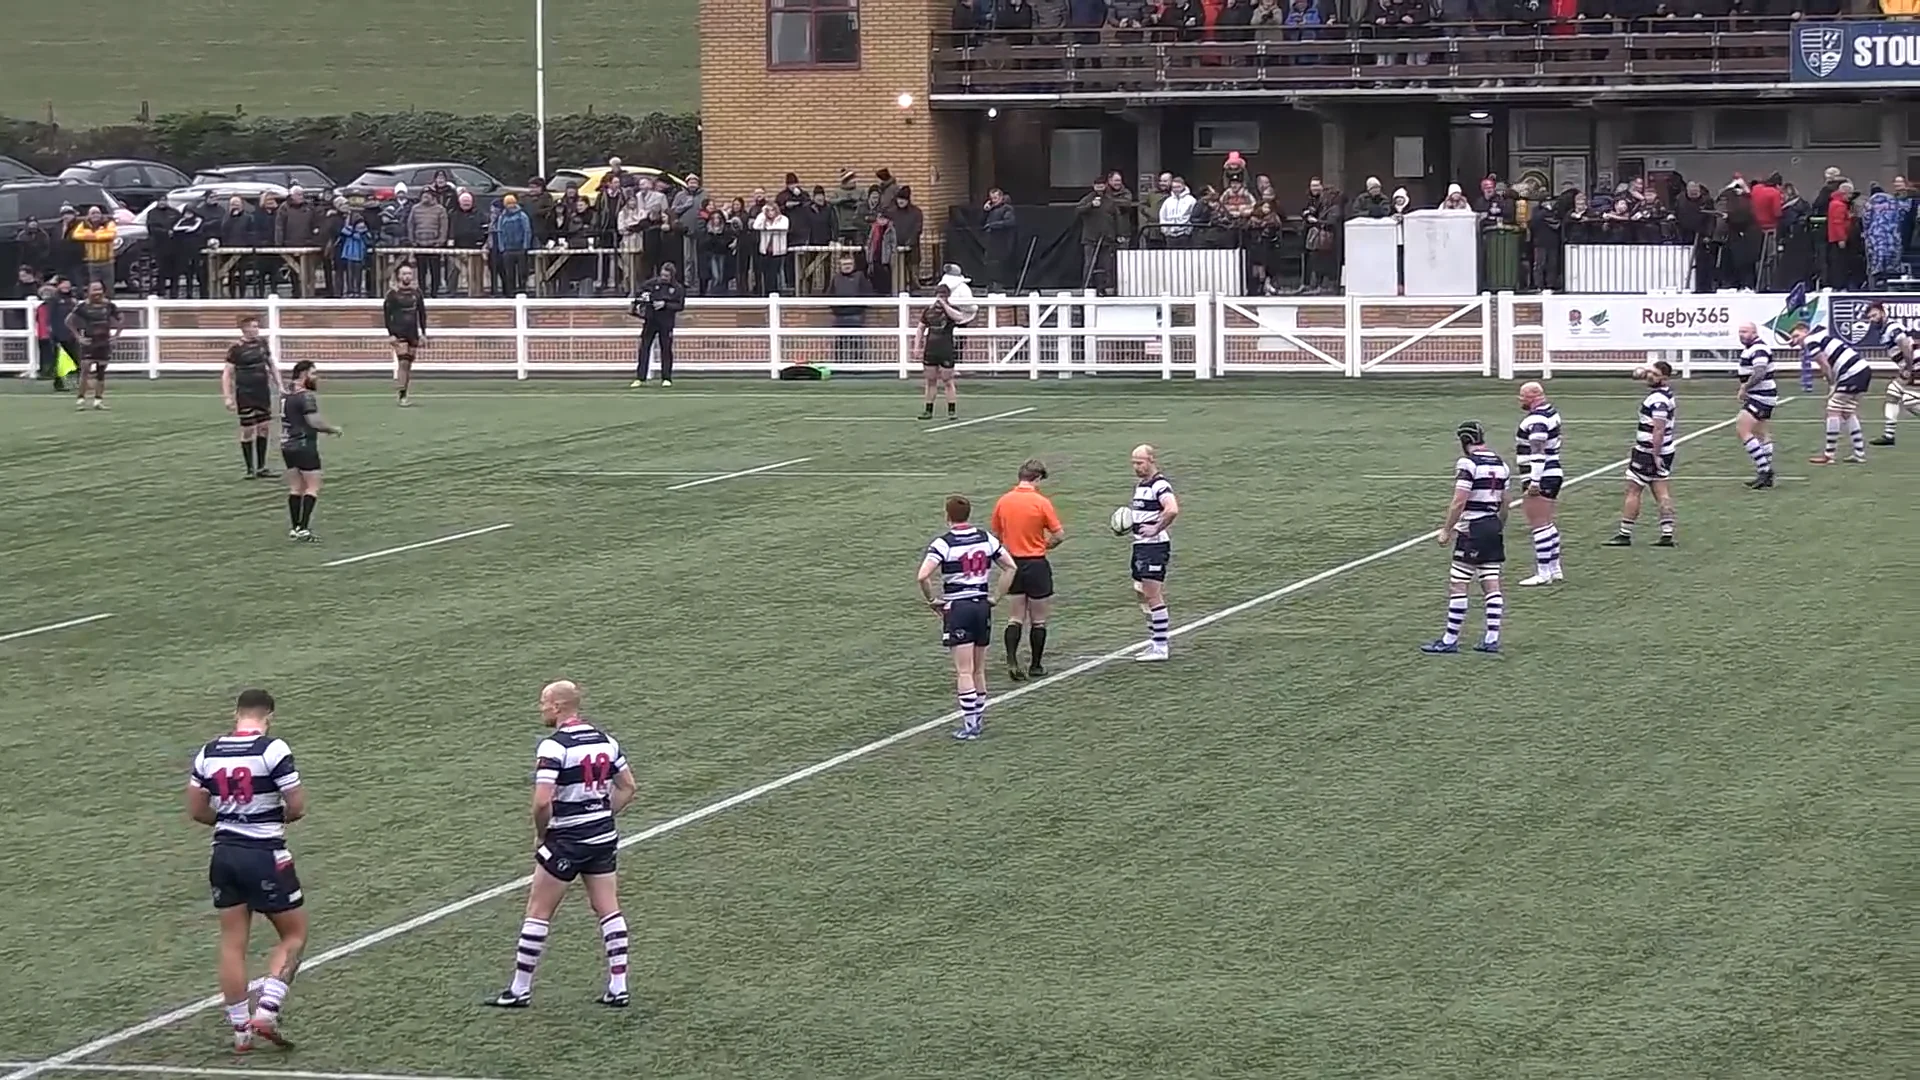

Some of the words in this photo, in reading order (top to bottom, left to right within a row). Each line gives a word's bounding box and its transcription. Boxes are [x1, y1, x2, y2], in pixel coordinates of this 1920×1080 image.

[1854, 36, 1920, 67] STOU
[1642, 307, 1729, 328] Rugby365
[958, 550, 987, 577] 10
[212, 766, 253, 805] 13
[580, 752, 610, 794] 12
